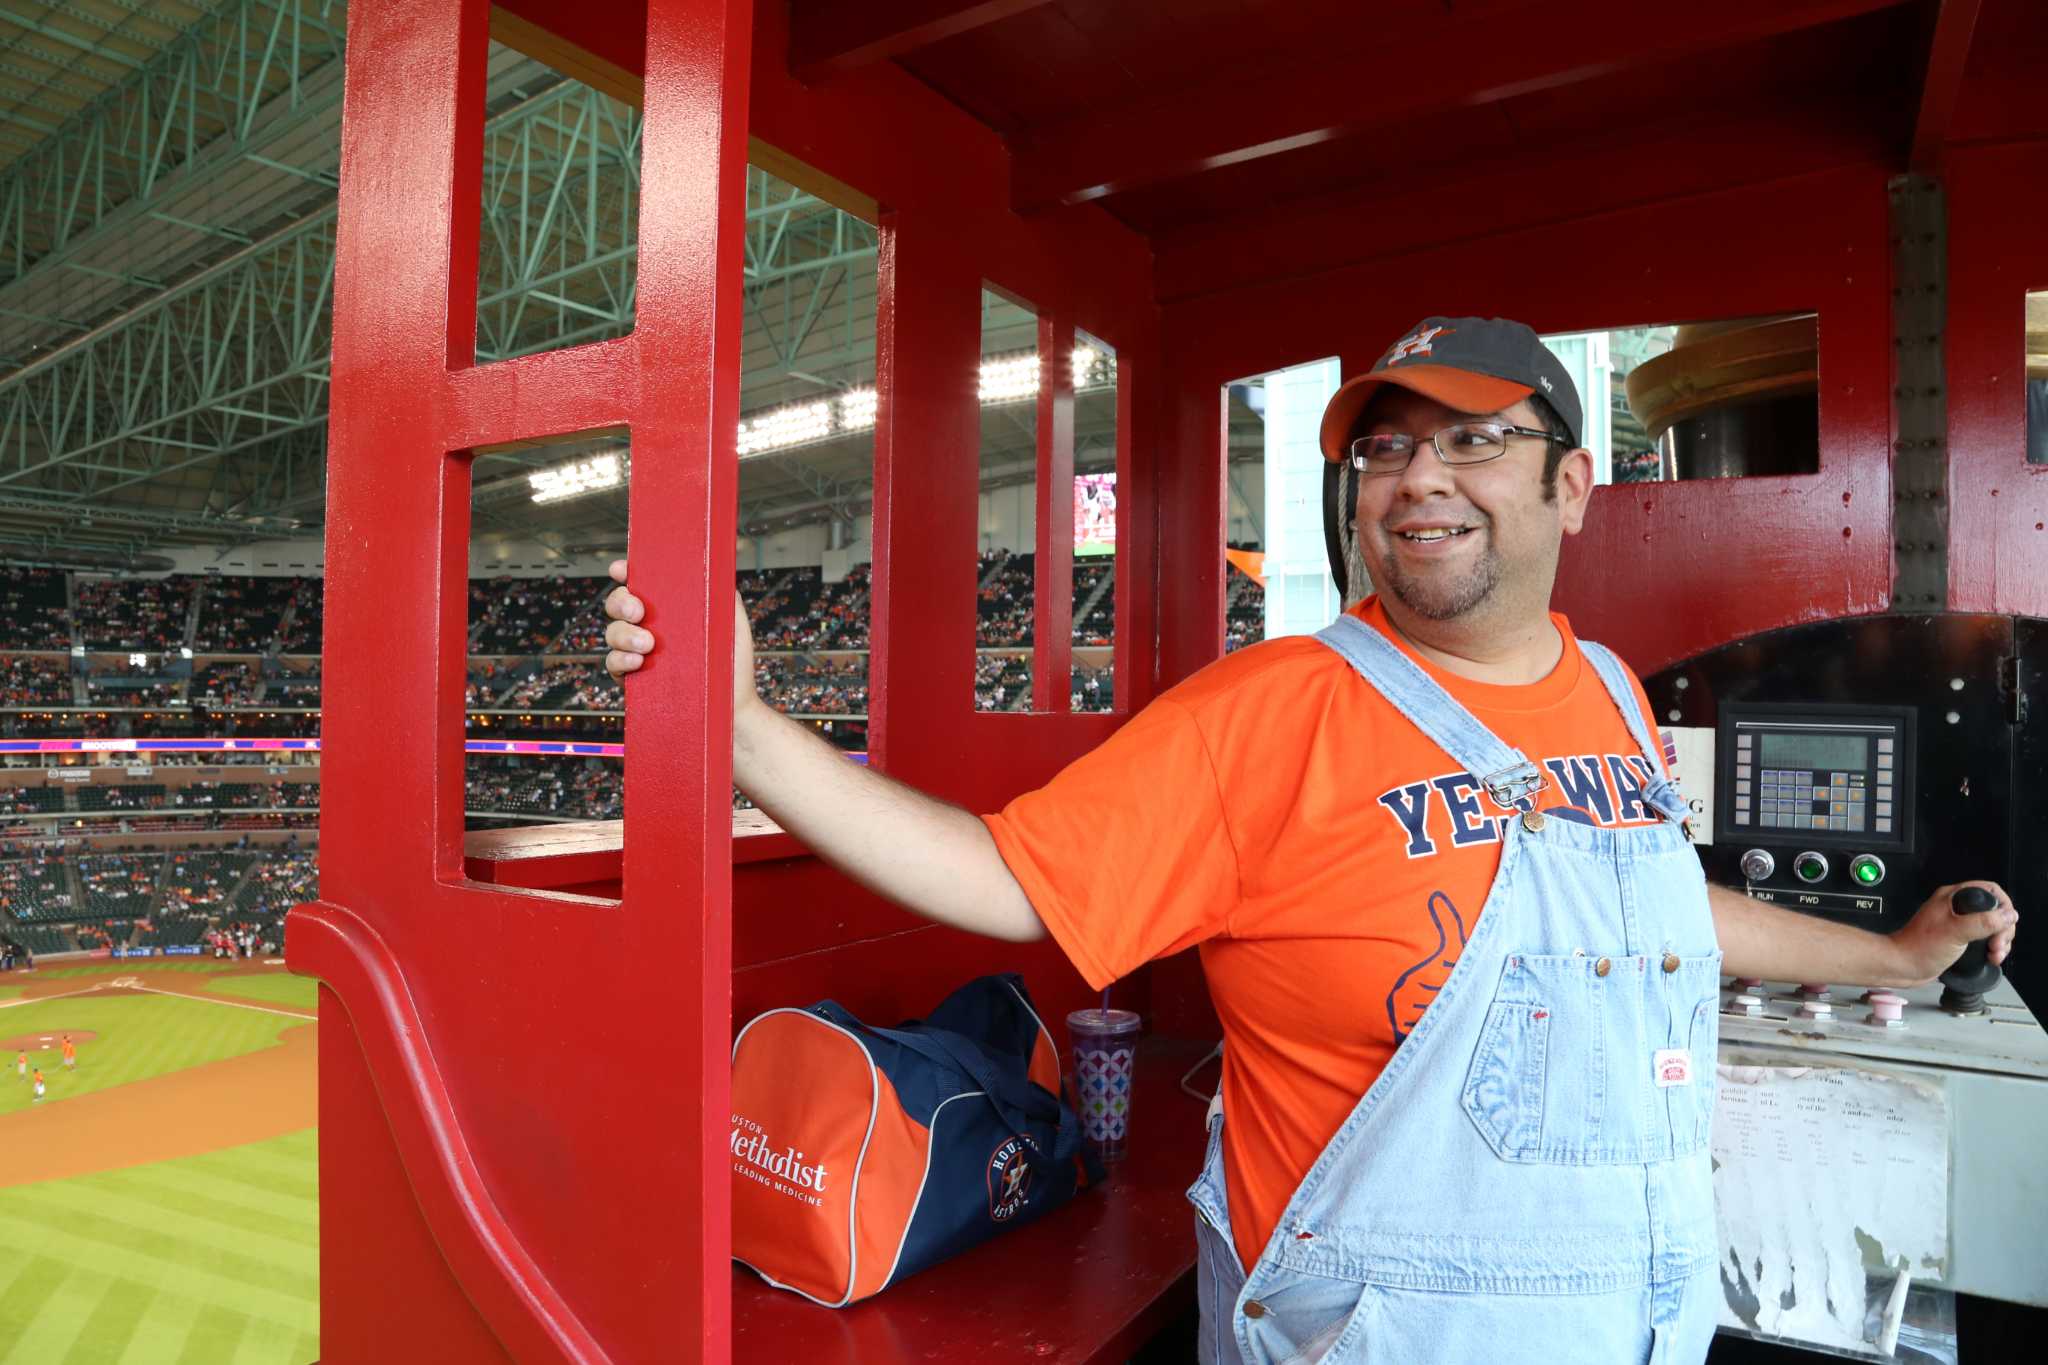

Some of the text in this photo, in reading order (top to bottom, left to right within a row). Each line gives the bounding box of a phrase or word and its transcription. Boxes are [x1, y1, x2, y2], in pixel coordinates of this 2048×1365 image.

[1756, 892, 1775, 902] RUN
[1799, 895, 1820, 905] FWD
[1856, 899, 1875, 910] REV
[734, 1162, 823, 1207] LEADING MEDICINE
